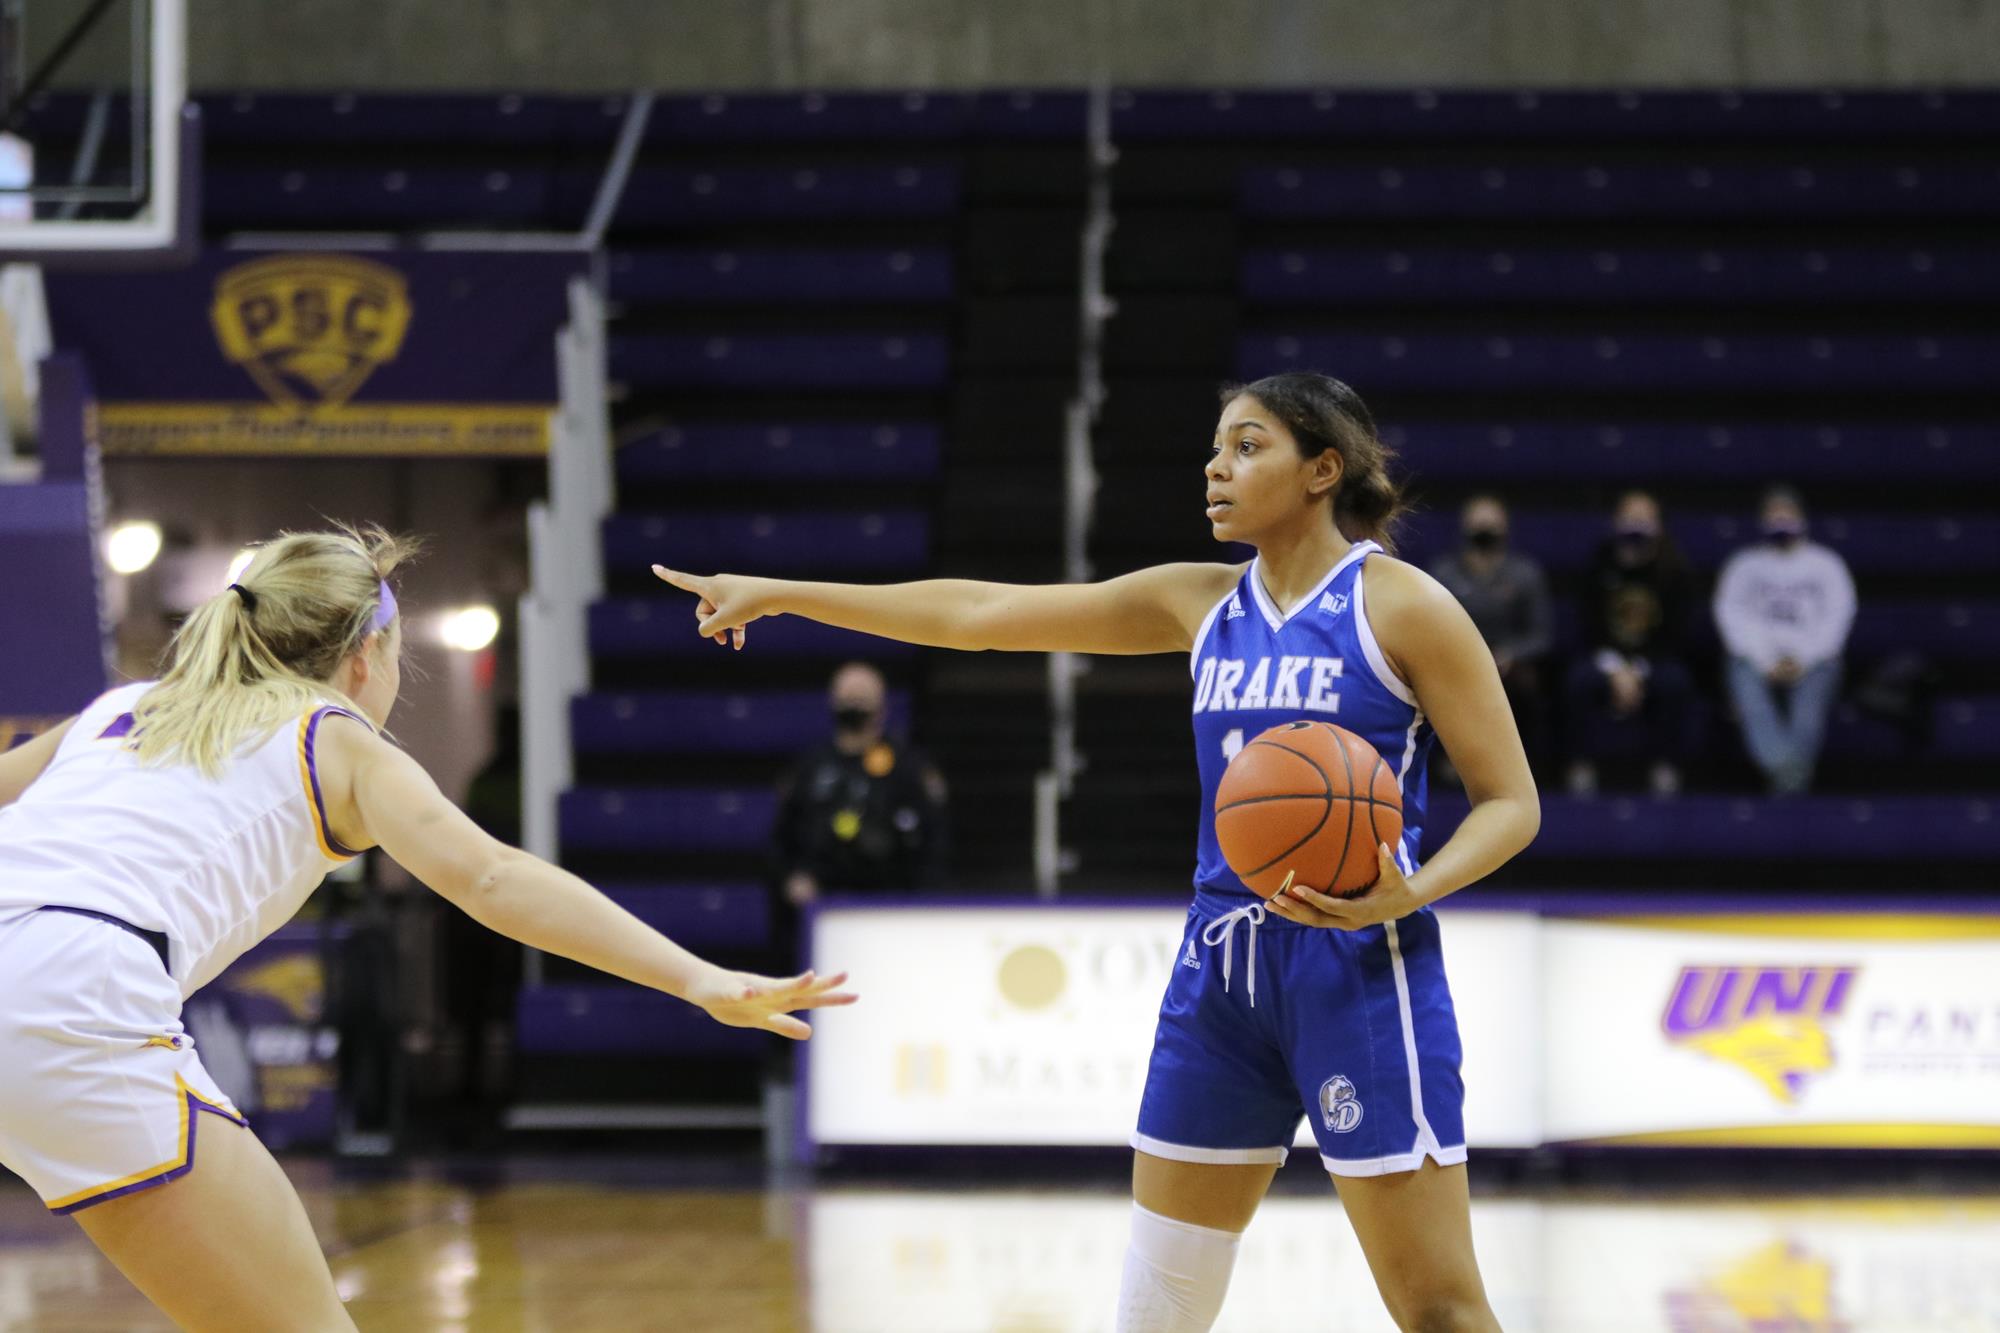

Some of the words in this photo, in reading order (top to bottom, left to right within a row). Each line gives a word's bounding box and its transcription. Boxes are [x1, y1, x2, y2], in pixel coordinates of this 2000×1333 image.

[238, 286, 392, 346] PSC
[1192, 655, 1345, 716] DRAKE
[1661, 965, 1861, 1042] UNI
[1867, 1004, 2000, 1045] PAN
